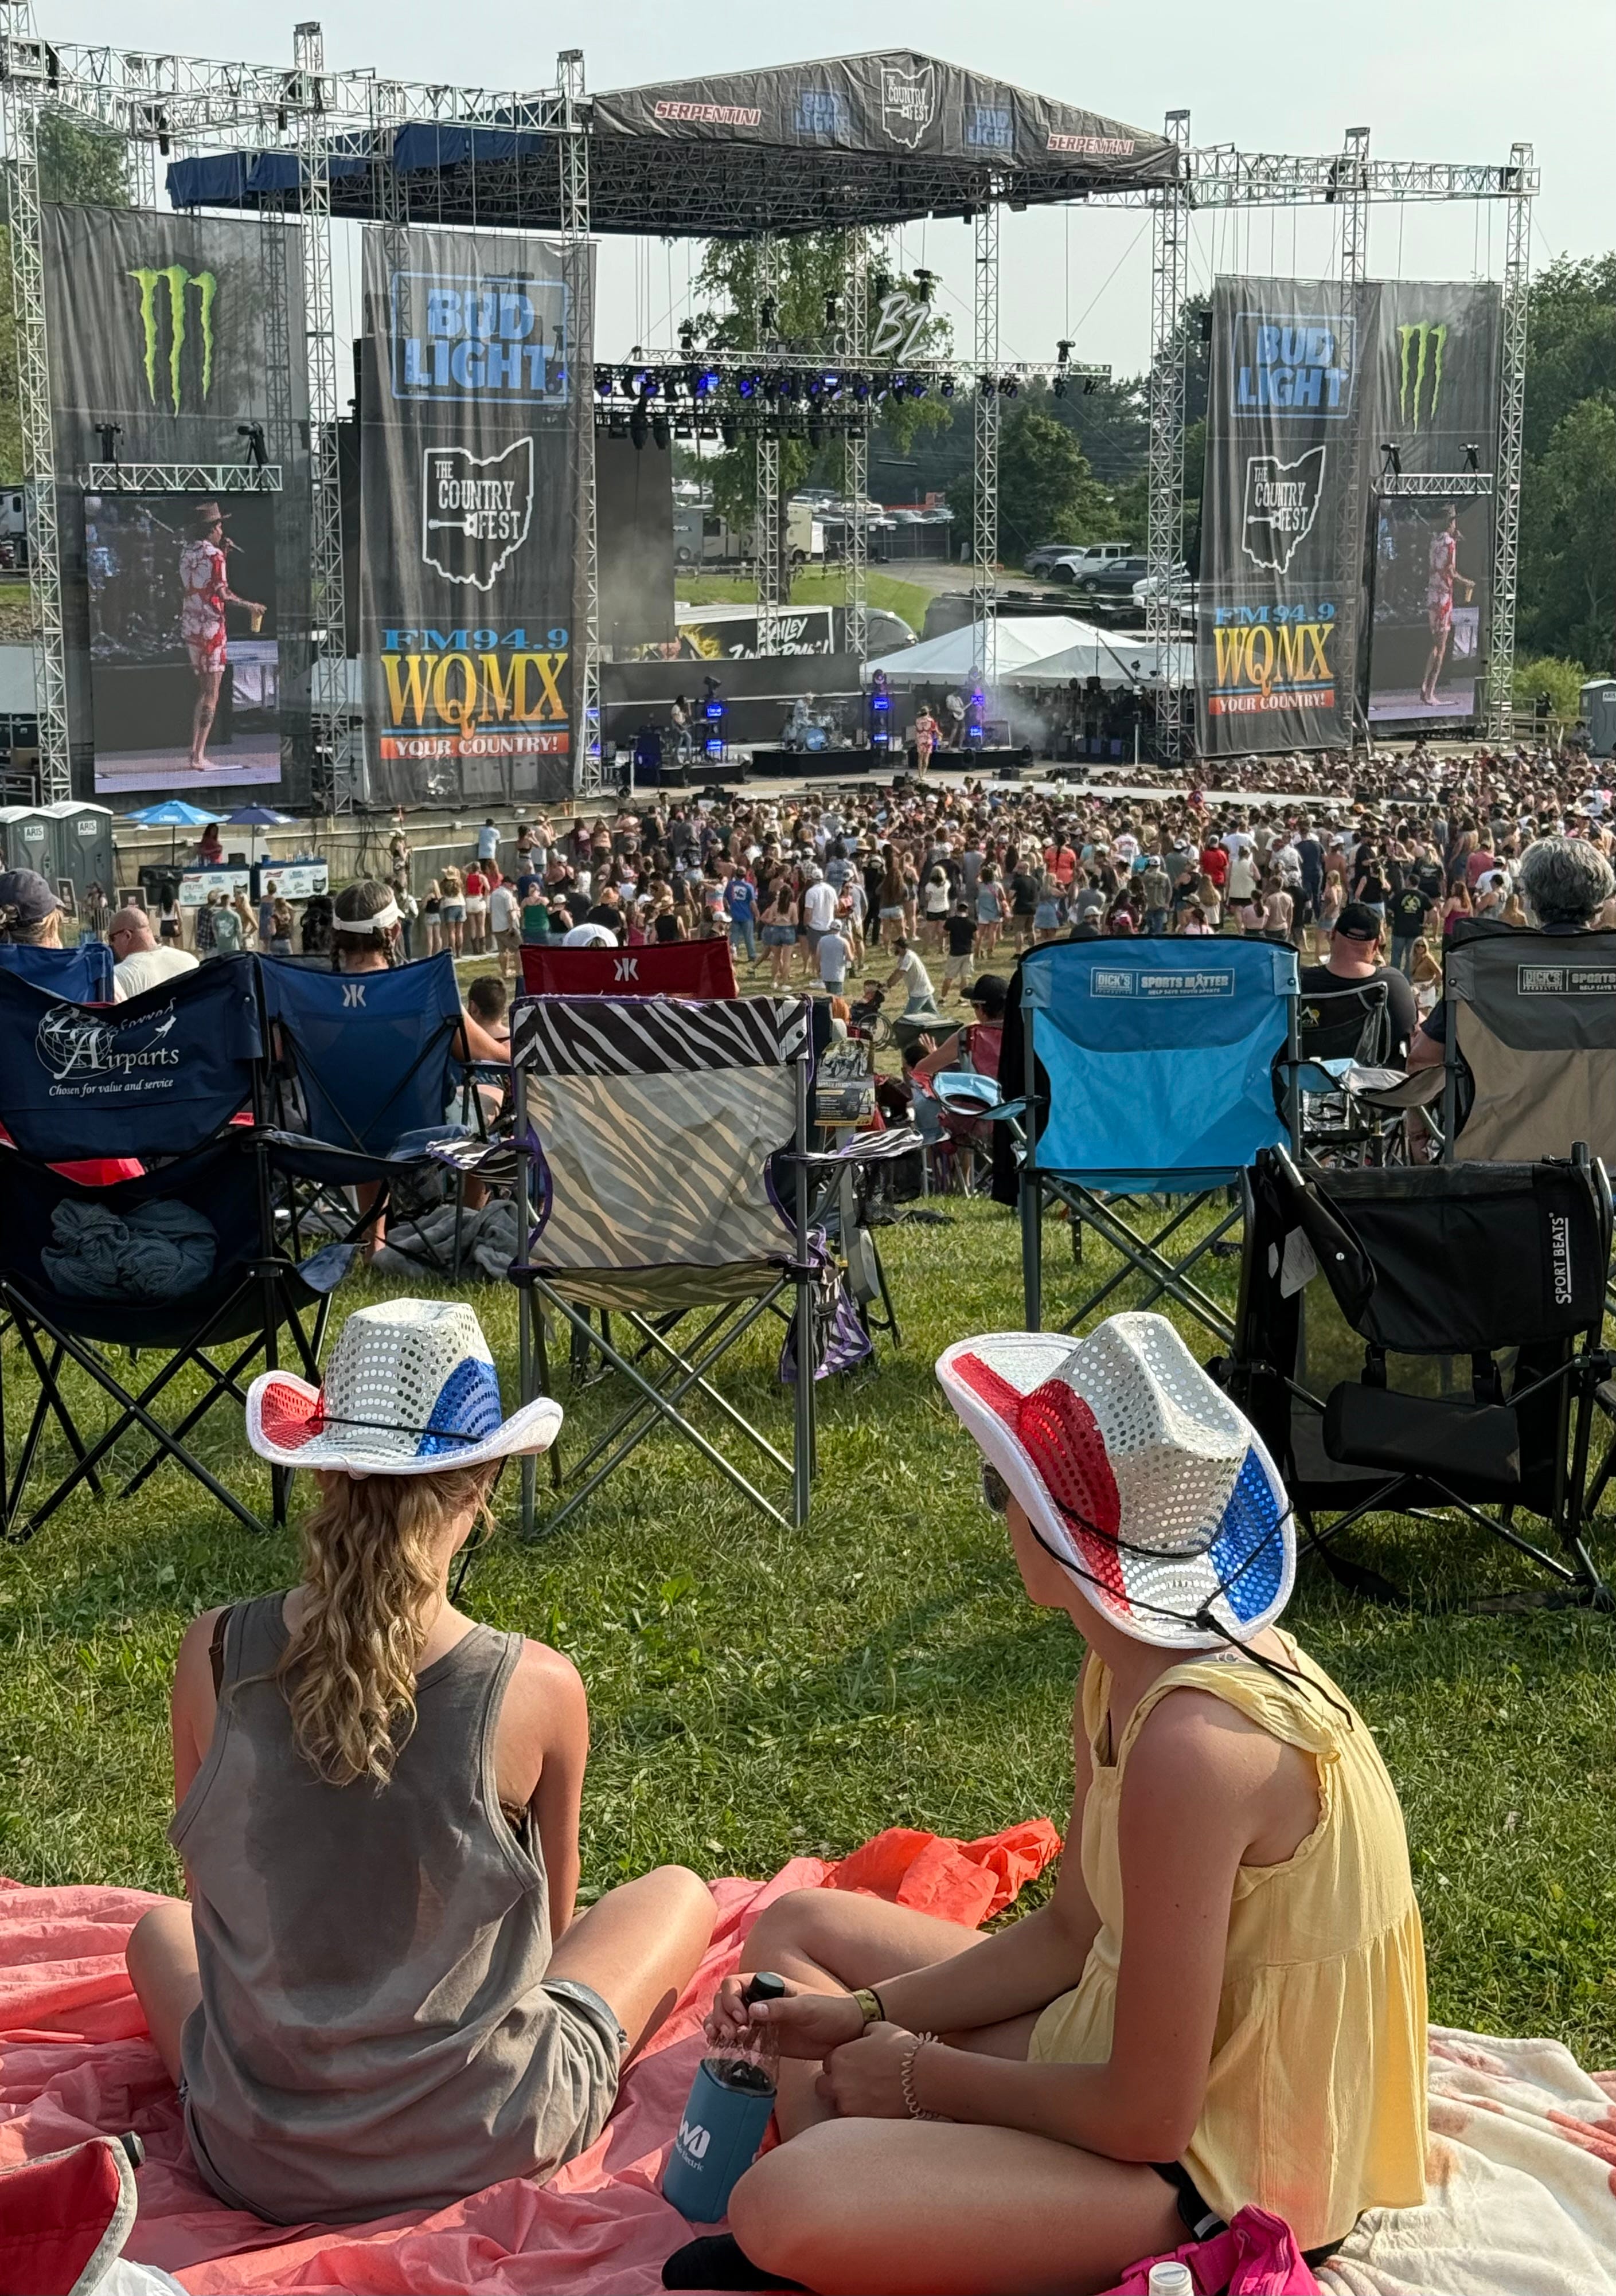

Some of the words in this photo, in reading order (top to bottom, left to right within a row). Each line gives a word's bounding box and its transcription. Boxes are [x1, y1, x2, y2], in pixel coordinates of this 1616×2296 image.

[889, 87, 927, 104] COUNTRY
[655, 101, 761, 126] SERPENTINI
[908, 104, 929, 122] FEST
[976, 109, 1009, 127] BUD
[967, 126, 1014, 147] LIGHT
[1046, 134, 1135, 156] SERPENTINI
[427, 288, 535, 340] BUD
[1256, 326, 1334, 367] BUD
[404, 339, 555, 390] LIGHT
[1238, 367, 1349, 407] LIGHT
[434, 461, 454, 479] THE
[1254, 467, 1268, 482] THE
[439, 479, 515, 510] COUNTRY
[1255, 482, 1306, 507] COUNTRY
[477, 511, 521, 539] FEST
[1279, 507, 1309, 531] FEST
[1213, 623, 1335, 697] WQMX
[380, 652, 568, 740] WQMX
[1220, 697, 1256, 712] YOUR
[1260, 693, 1325, 710] COUNTRY!
[395, 738, 451, 757] YOUR
[459, 736, 558, 754] COUNTRY!
[1098, 974, 1130, 986] DICK'S
[1141, 976, 1183, 988] SPORTS
[1525, 971, 1560, 983] DICK'S
[1571, 973, 1616, 984] SPORTS
[53, 1027, 179, 1080] Airparts
[49, 1084, 80, 1097] Chosen
[80, 1083, 96, 1098] for
[98, 1082, 122, 1093] value
[124, 1079, 144, 1092] and
[143, 1079, 174, 1090] service
[1552, 1217, 1565, 1257] BEATS
[1553, 1260, 1572, 1304] SPORT
